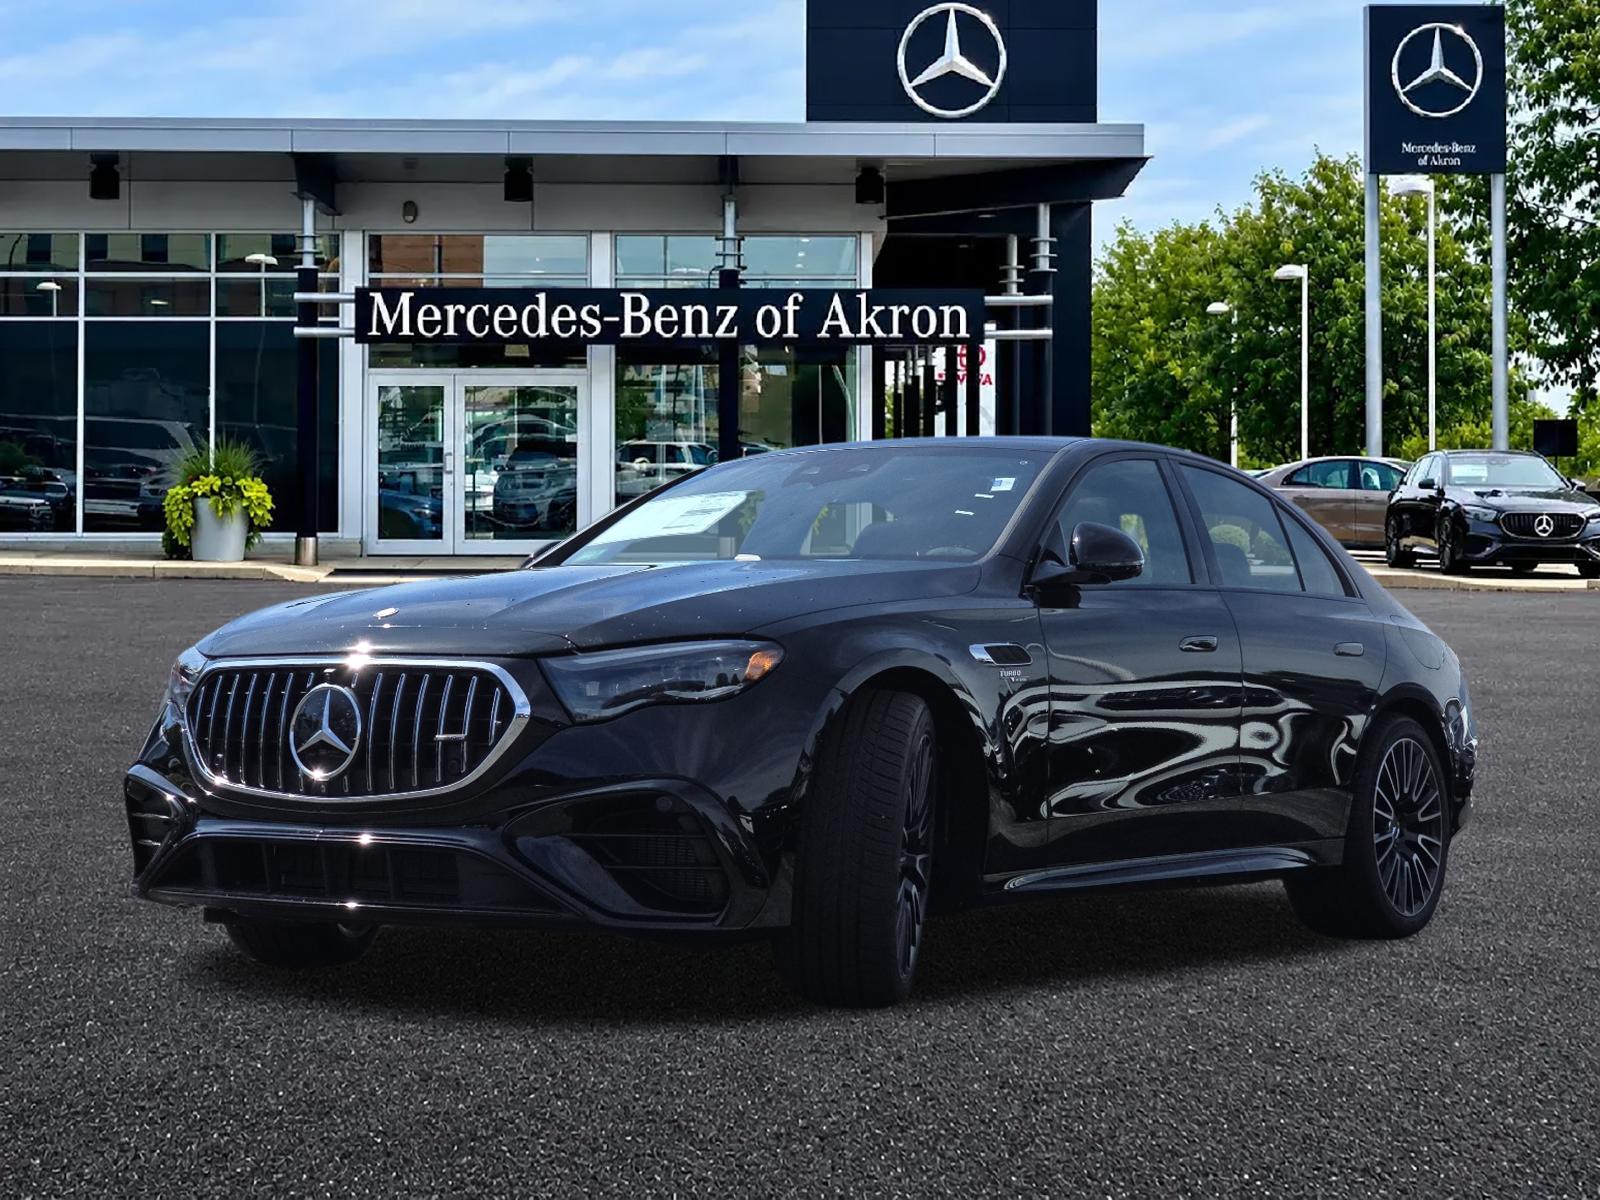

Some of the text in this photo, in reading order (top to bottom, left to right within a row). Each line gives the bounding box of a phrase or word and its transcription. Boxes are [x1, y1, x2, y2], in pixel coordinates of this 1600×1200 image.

[1401, 142, 1476, 153] Mercedes-Benz
[1417, 154, 1460, 165] of Akron
[367, 292, 970, 338] Mercedes-Benz of Akron
